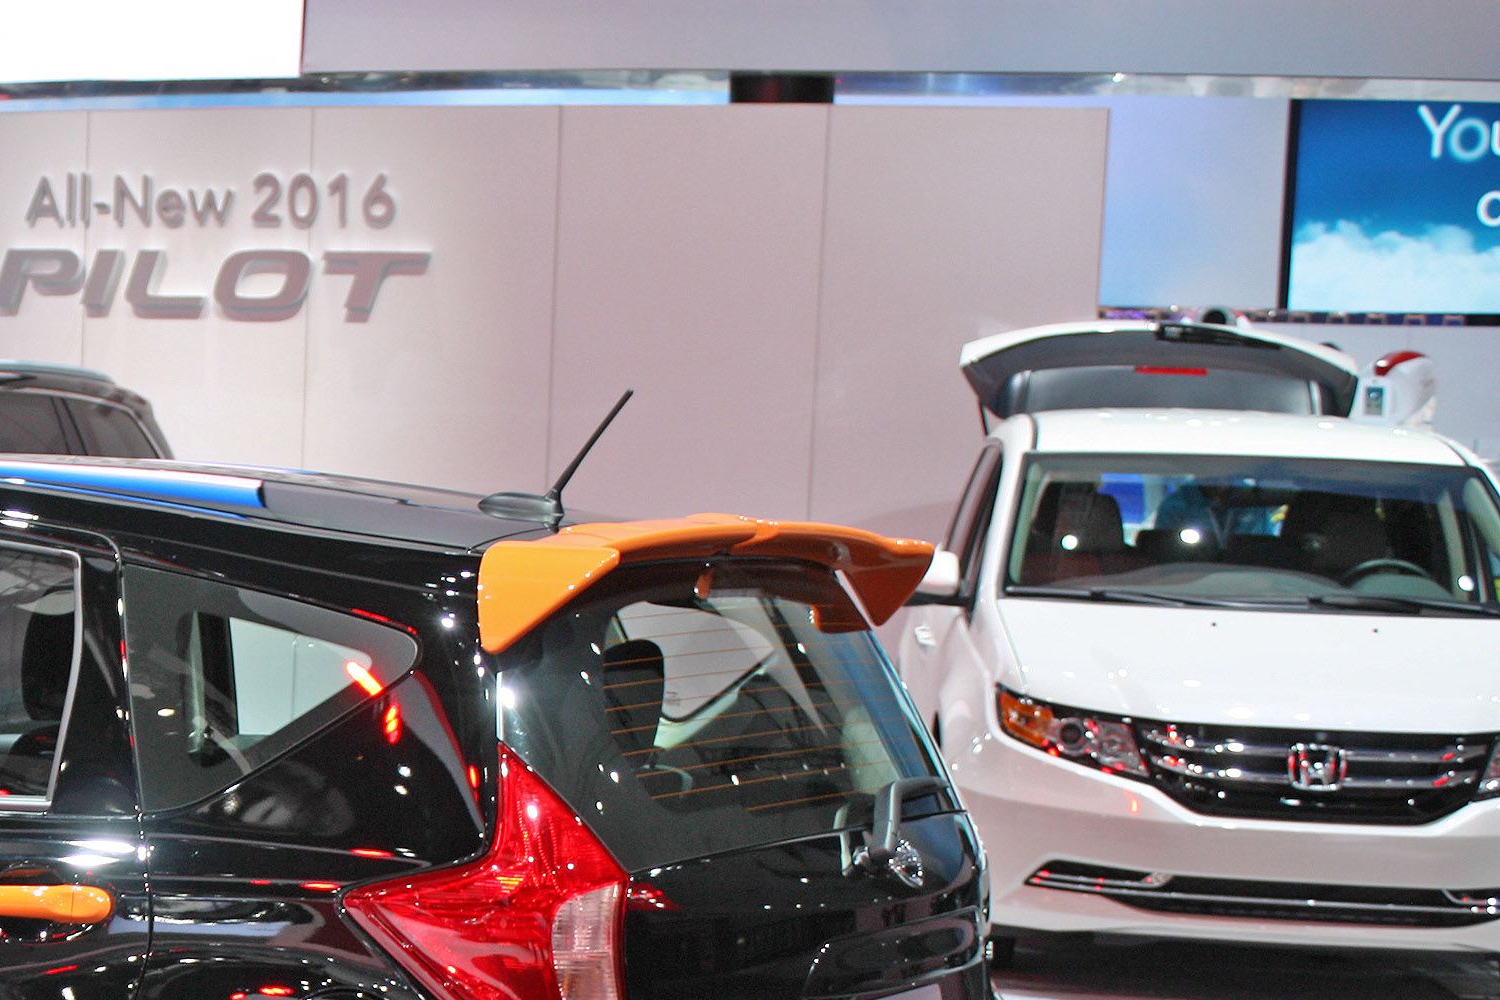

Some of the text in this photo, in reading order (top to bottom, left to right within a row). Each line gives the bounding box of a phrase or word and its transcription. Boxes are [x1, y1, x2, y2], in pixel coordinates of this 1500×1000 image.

[1417, 104, 1500, 162] Yo
[25, 171, 398, 229] All-New 2016
